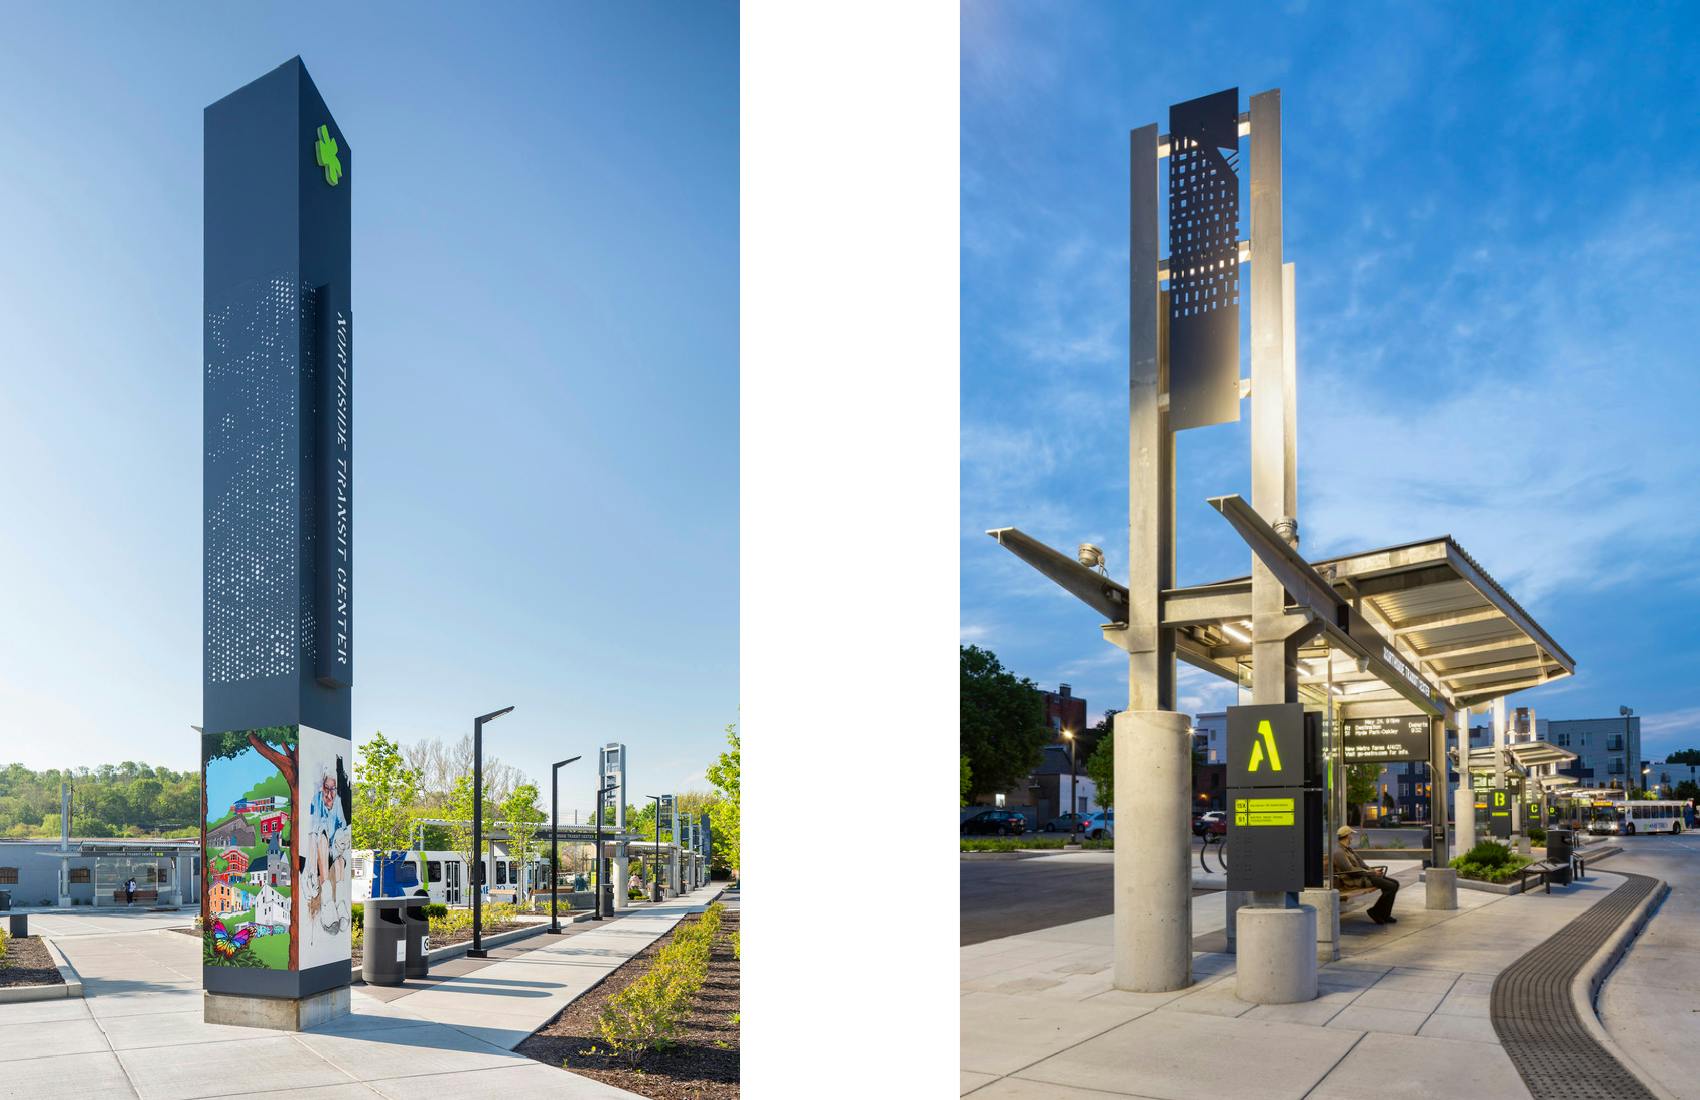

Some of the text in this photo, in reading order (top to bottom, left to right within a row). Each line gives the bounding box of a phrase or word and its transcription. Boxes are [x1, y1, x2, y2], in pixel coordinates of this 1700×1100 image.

[337, 311, 347, 665] NORTHSIDE TRANSIT CENTER
[1248, 720, 1282, 772] A
[1494, 792, 1505, 807] B
[1530, 804, 1538, 813] C
